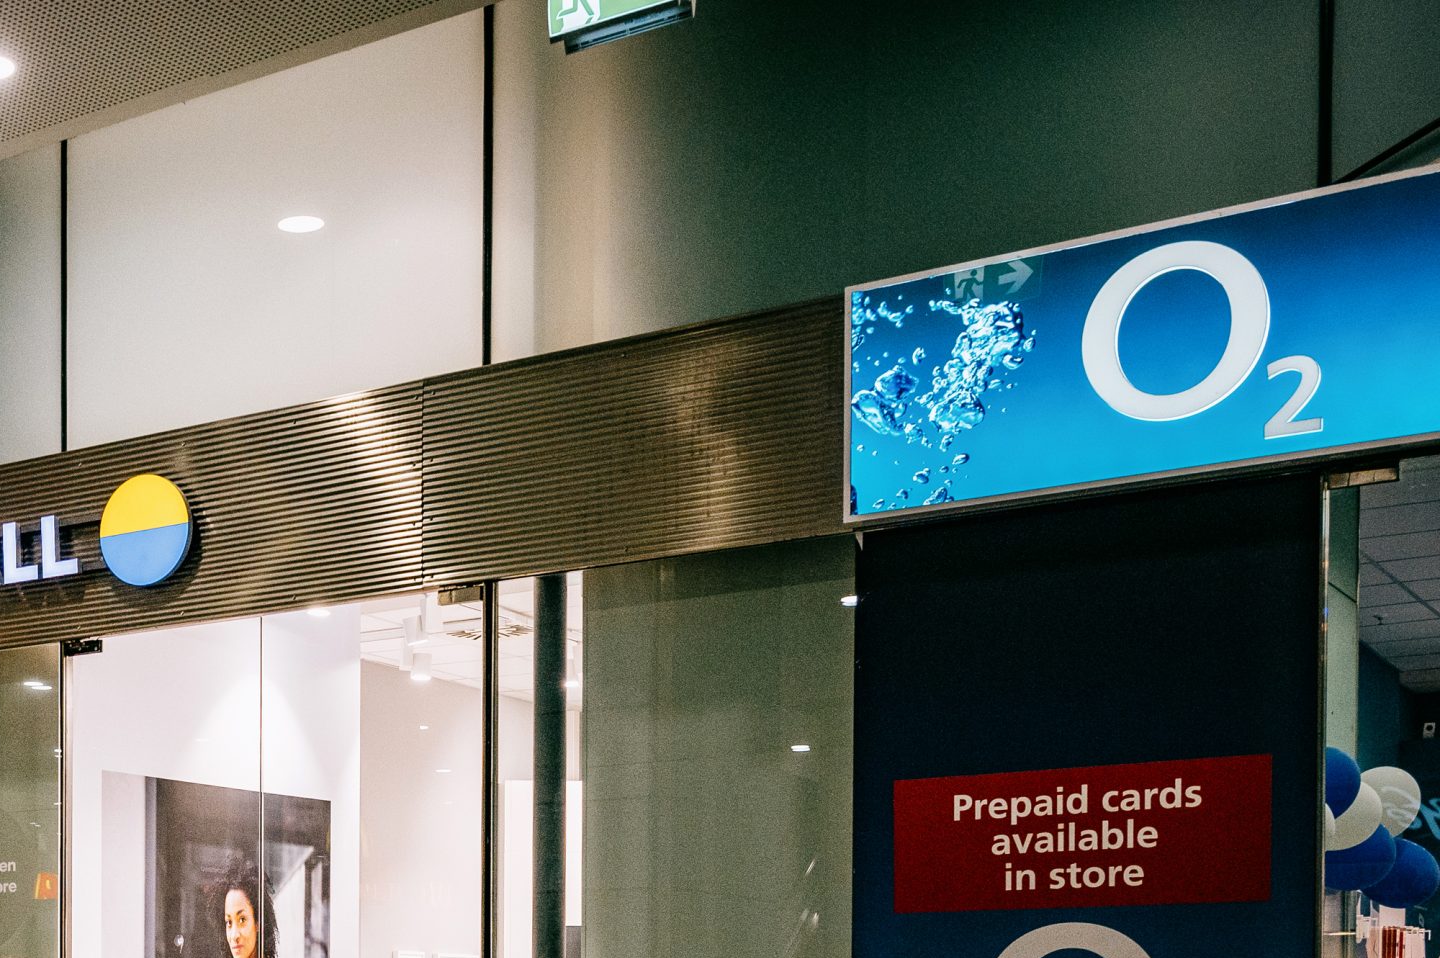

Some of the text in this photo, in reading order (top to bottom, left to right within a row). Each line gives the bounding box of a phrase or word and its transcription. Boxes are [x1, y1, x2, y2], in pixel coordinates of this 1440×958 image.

[952, 777, 1203, 826] Prepaid cards
[990, 818, 1159, 856] available
[1003, 861, 1146, 892] in store
